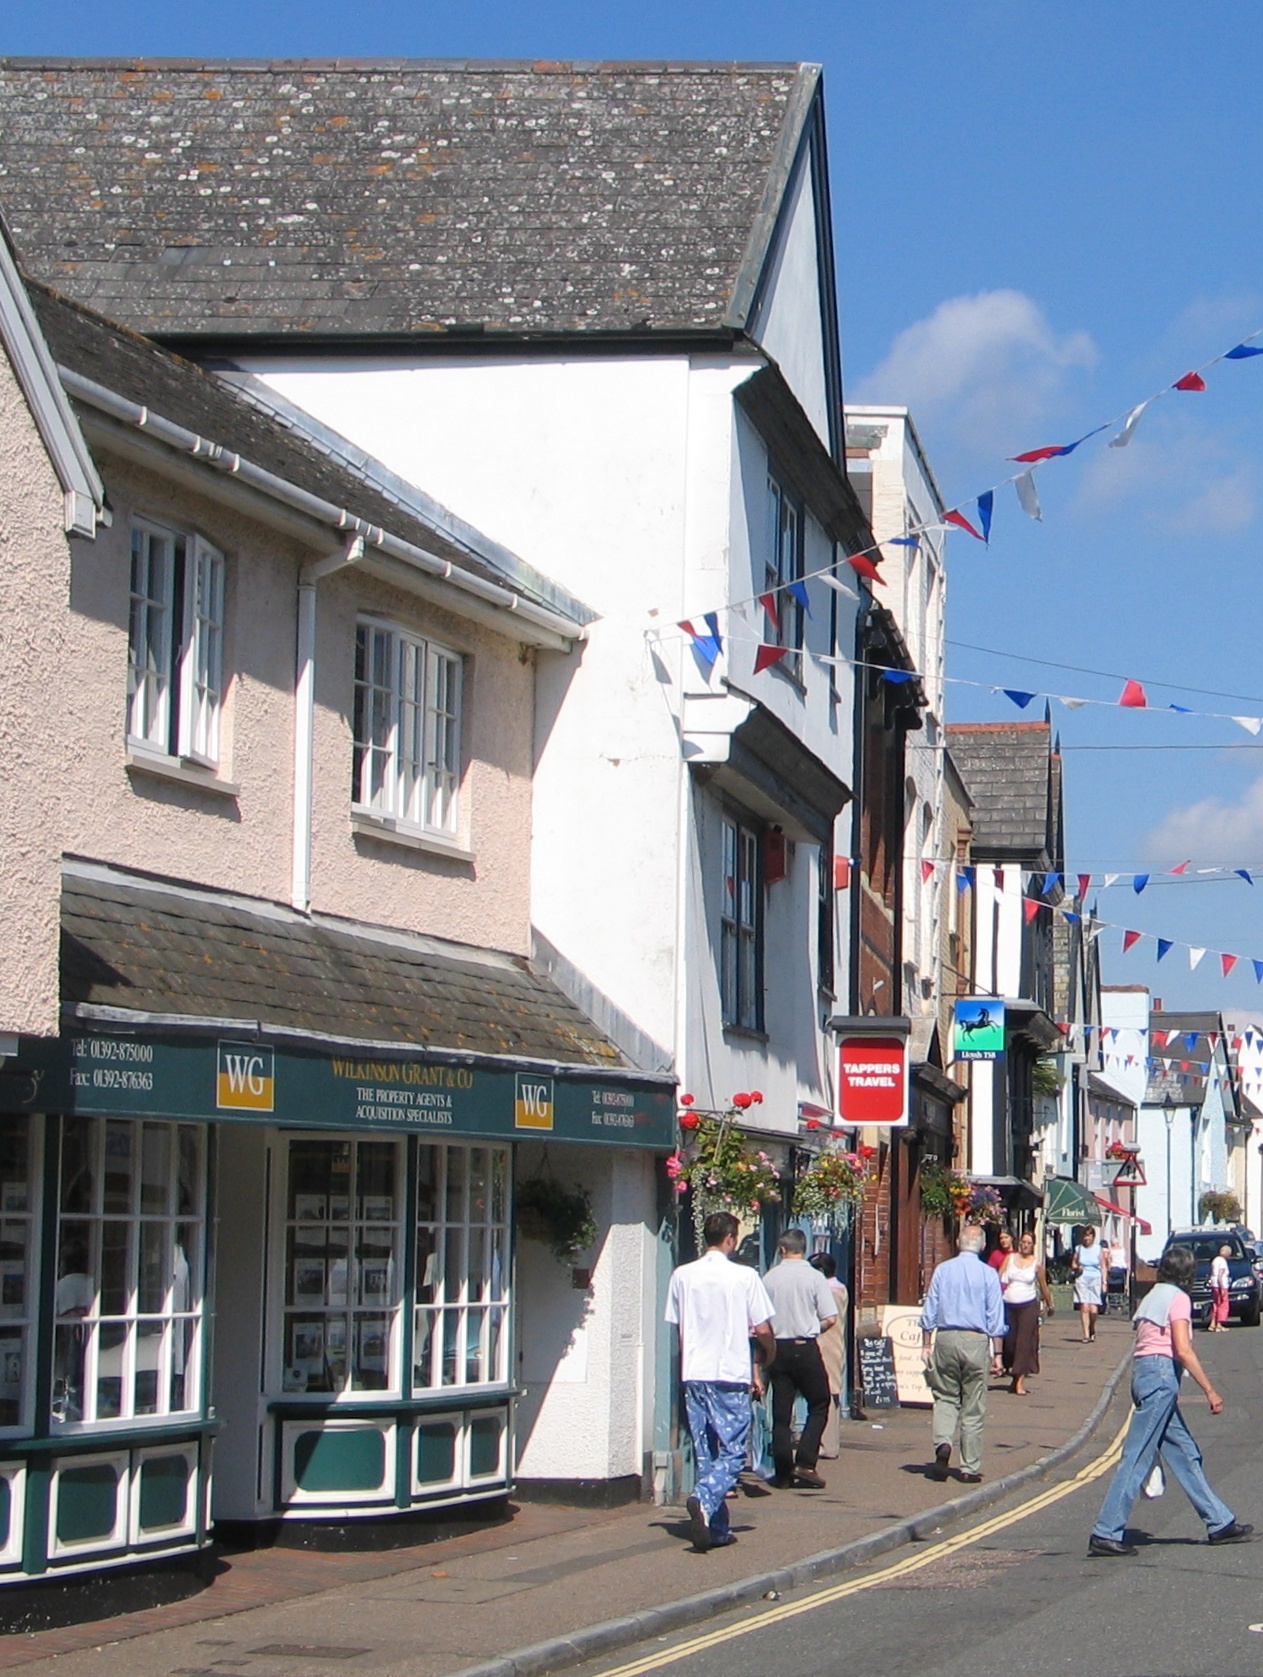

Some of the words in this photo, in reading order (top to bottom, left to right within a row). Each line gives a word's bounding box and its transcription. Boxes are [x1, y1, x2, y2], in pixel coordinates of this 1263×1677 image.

[90, 1042, 153, 1062] 01392-875000
[70, 1067, 89, 1086] Fax:
[93, 1069, 153, 1090] 01392-876363
[225, 1054, 265, 1095] WG
[332, 1056, 399, 1082] WILKINSON
[402, 1063, 444, 1086] GRANT
[457, 1068, 474, 1089] CO
[843, 1063, 900, 1074] TAPPERS
[848, 1077, 896, 1087] TRAVEL
[356, 1087, 375, 1101] THE
[376, 1090, 415, 1105] PROPERTY
[416, 1093, 445, 1107] AGENTS
[521, 1084, 547, 1117] WG
[356, 1105, 405, 1121] ACQUISITION
[407, 1108, 453, 1124] SPECIALISTS
[1062, 1208, 1084, 1217] Florist
